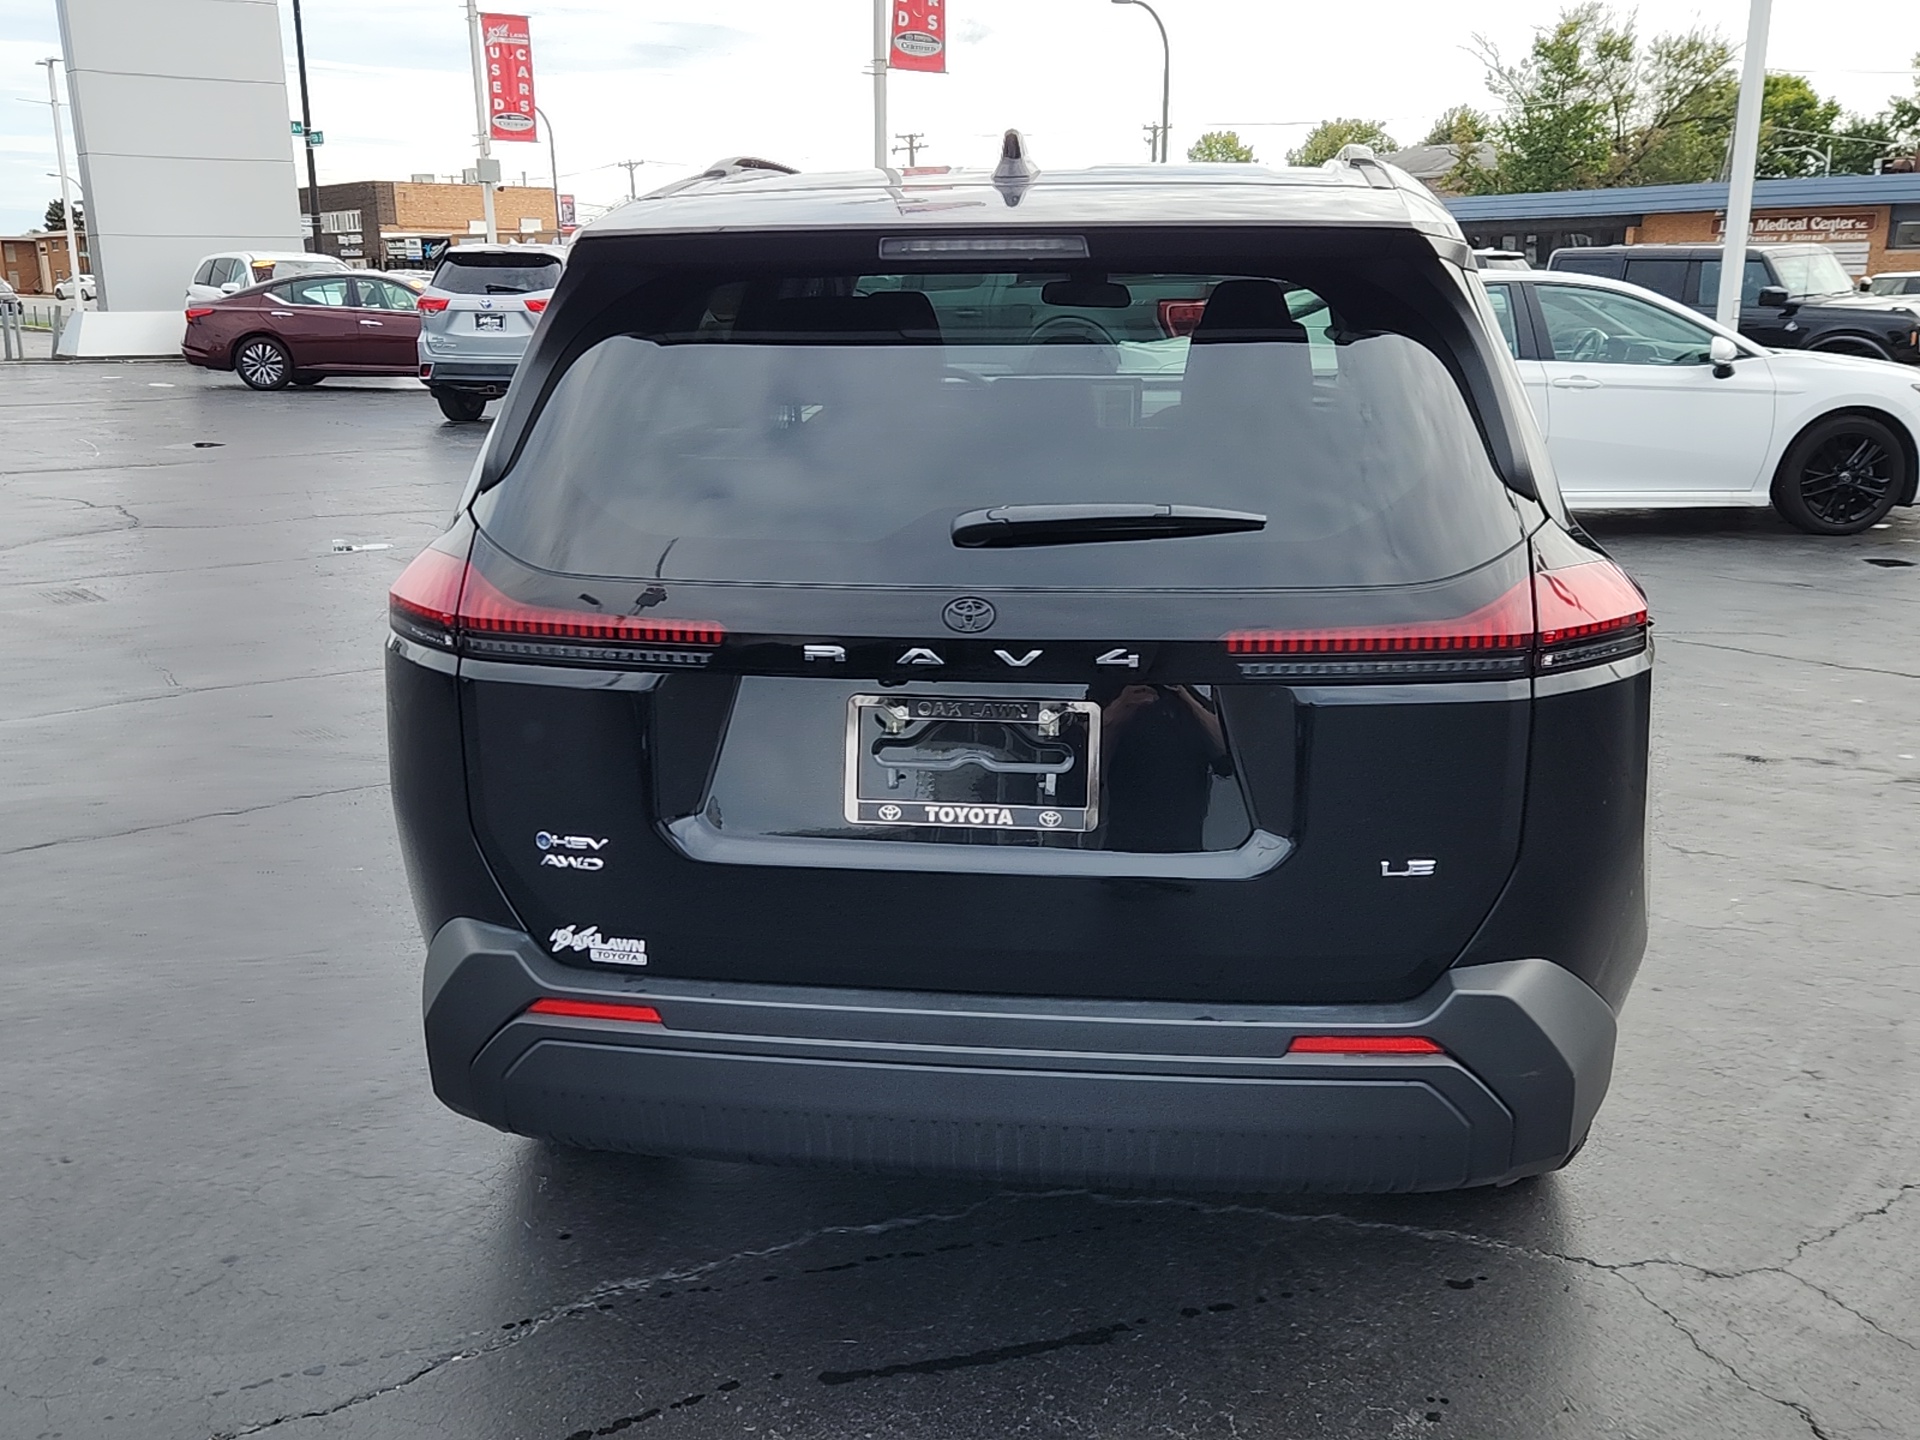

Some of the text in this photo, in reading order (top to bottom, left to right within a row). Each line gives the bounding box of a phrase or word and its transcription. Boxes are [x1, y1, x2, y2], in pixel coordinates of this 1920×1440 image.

[489, 46, 505, 111] USED
[516, 48, 530, 113] CARS
[1755, 217, 1808, 232] Medical
[1810, 216, 1856, 233] Center
[803, 644, 1140, 669] RAV4
[916, 700, 1029, 719] OAK LAWN
[924, 805, 1014, 826] TOYOTA
[540, 853, 605, 871] AWD
[1380, 859, 1437, 877] LE
[596, 951, 639, 961] TOYOTA
